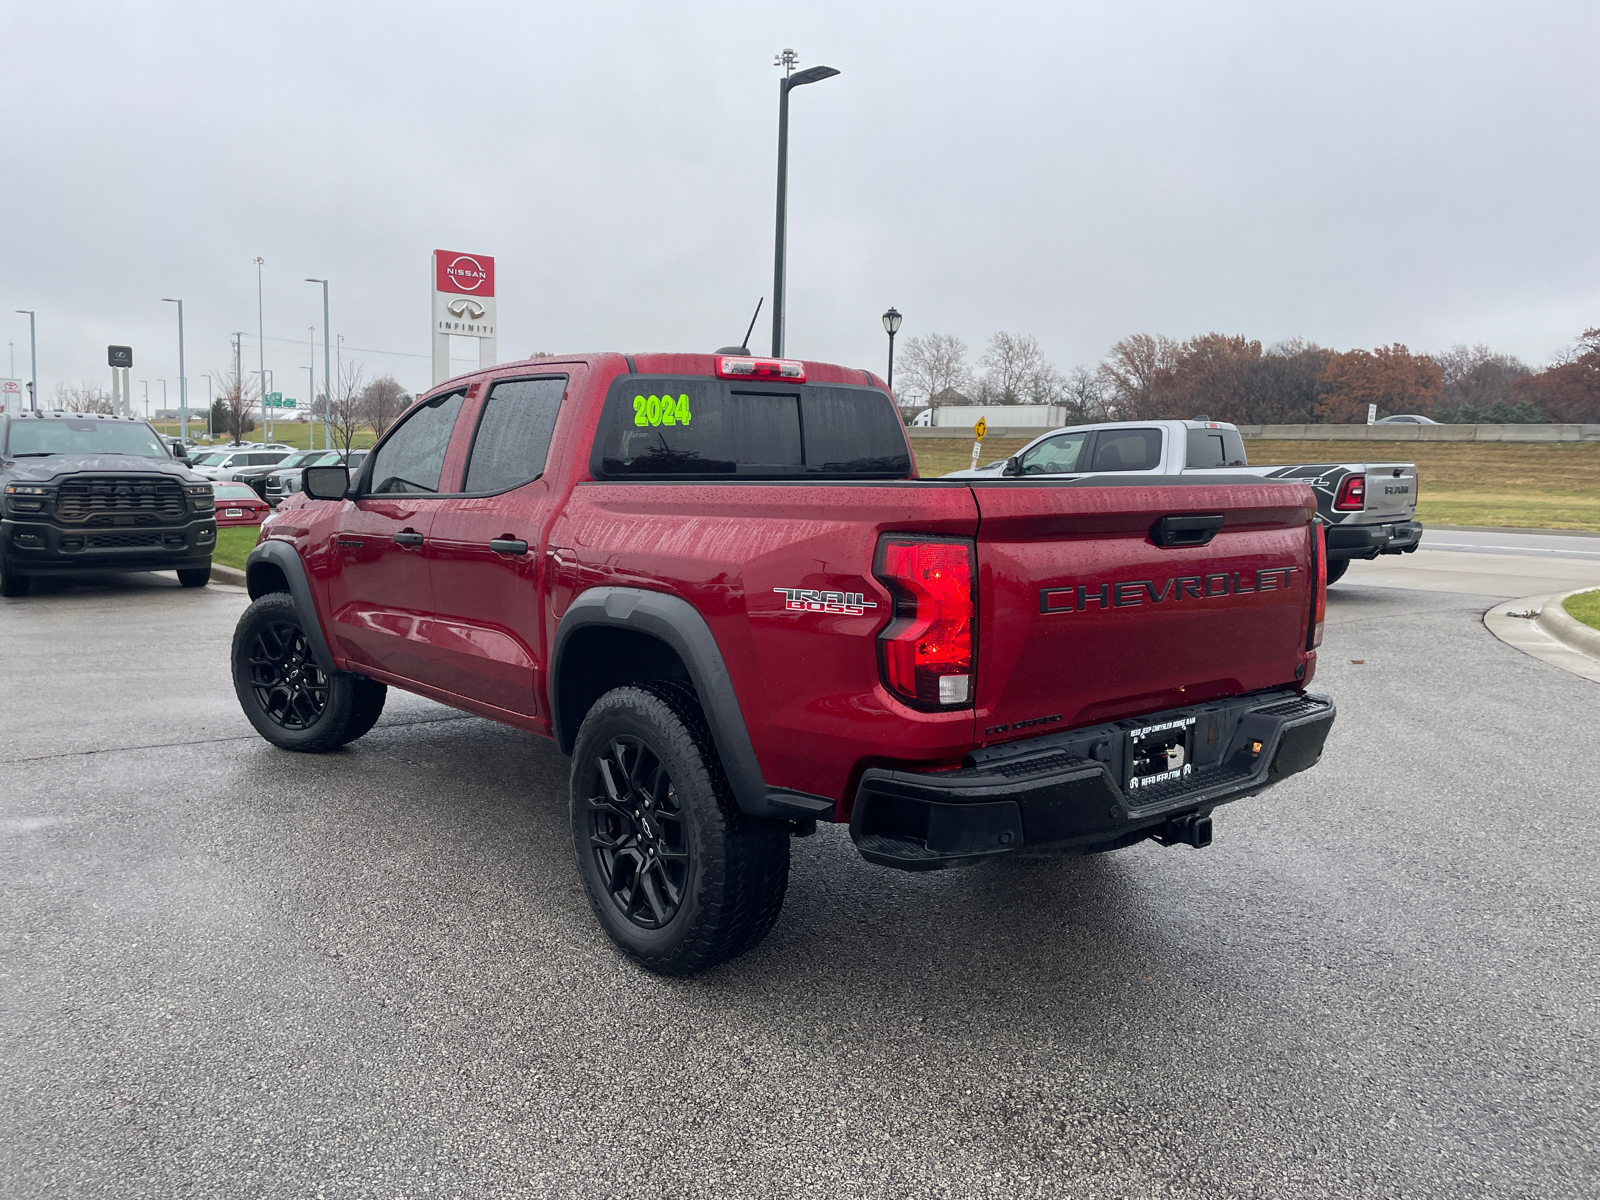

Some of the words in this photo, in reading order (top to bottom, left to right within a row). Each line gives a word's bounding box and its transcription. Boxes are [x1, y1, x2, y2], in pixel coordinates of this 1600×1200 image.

[447, 267, 486, 279] NISSAN
[439, 321, 493, 334] INFINITI
[633, 394, 691, 427] 2024
[91, 485, 154, 495] RAM
[1384, 485, 1409, 495] RAM
[773, 587, 877, 608] TRAIL
[1040, 566, 1299, 615] CHEVROLET
[786, 600, 863, 616] BOSS
[985, 713, 1063, 735] COLORADO
[1152, 722, 1172, 732] CHRYSLER
[1173, 719, 1186, 728] DODGE
[1186, 717, 1196, 725] RAM
